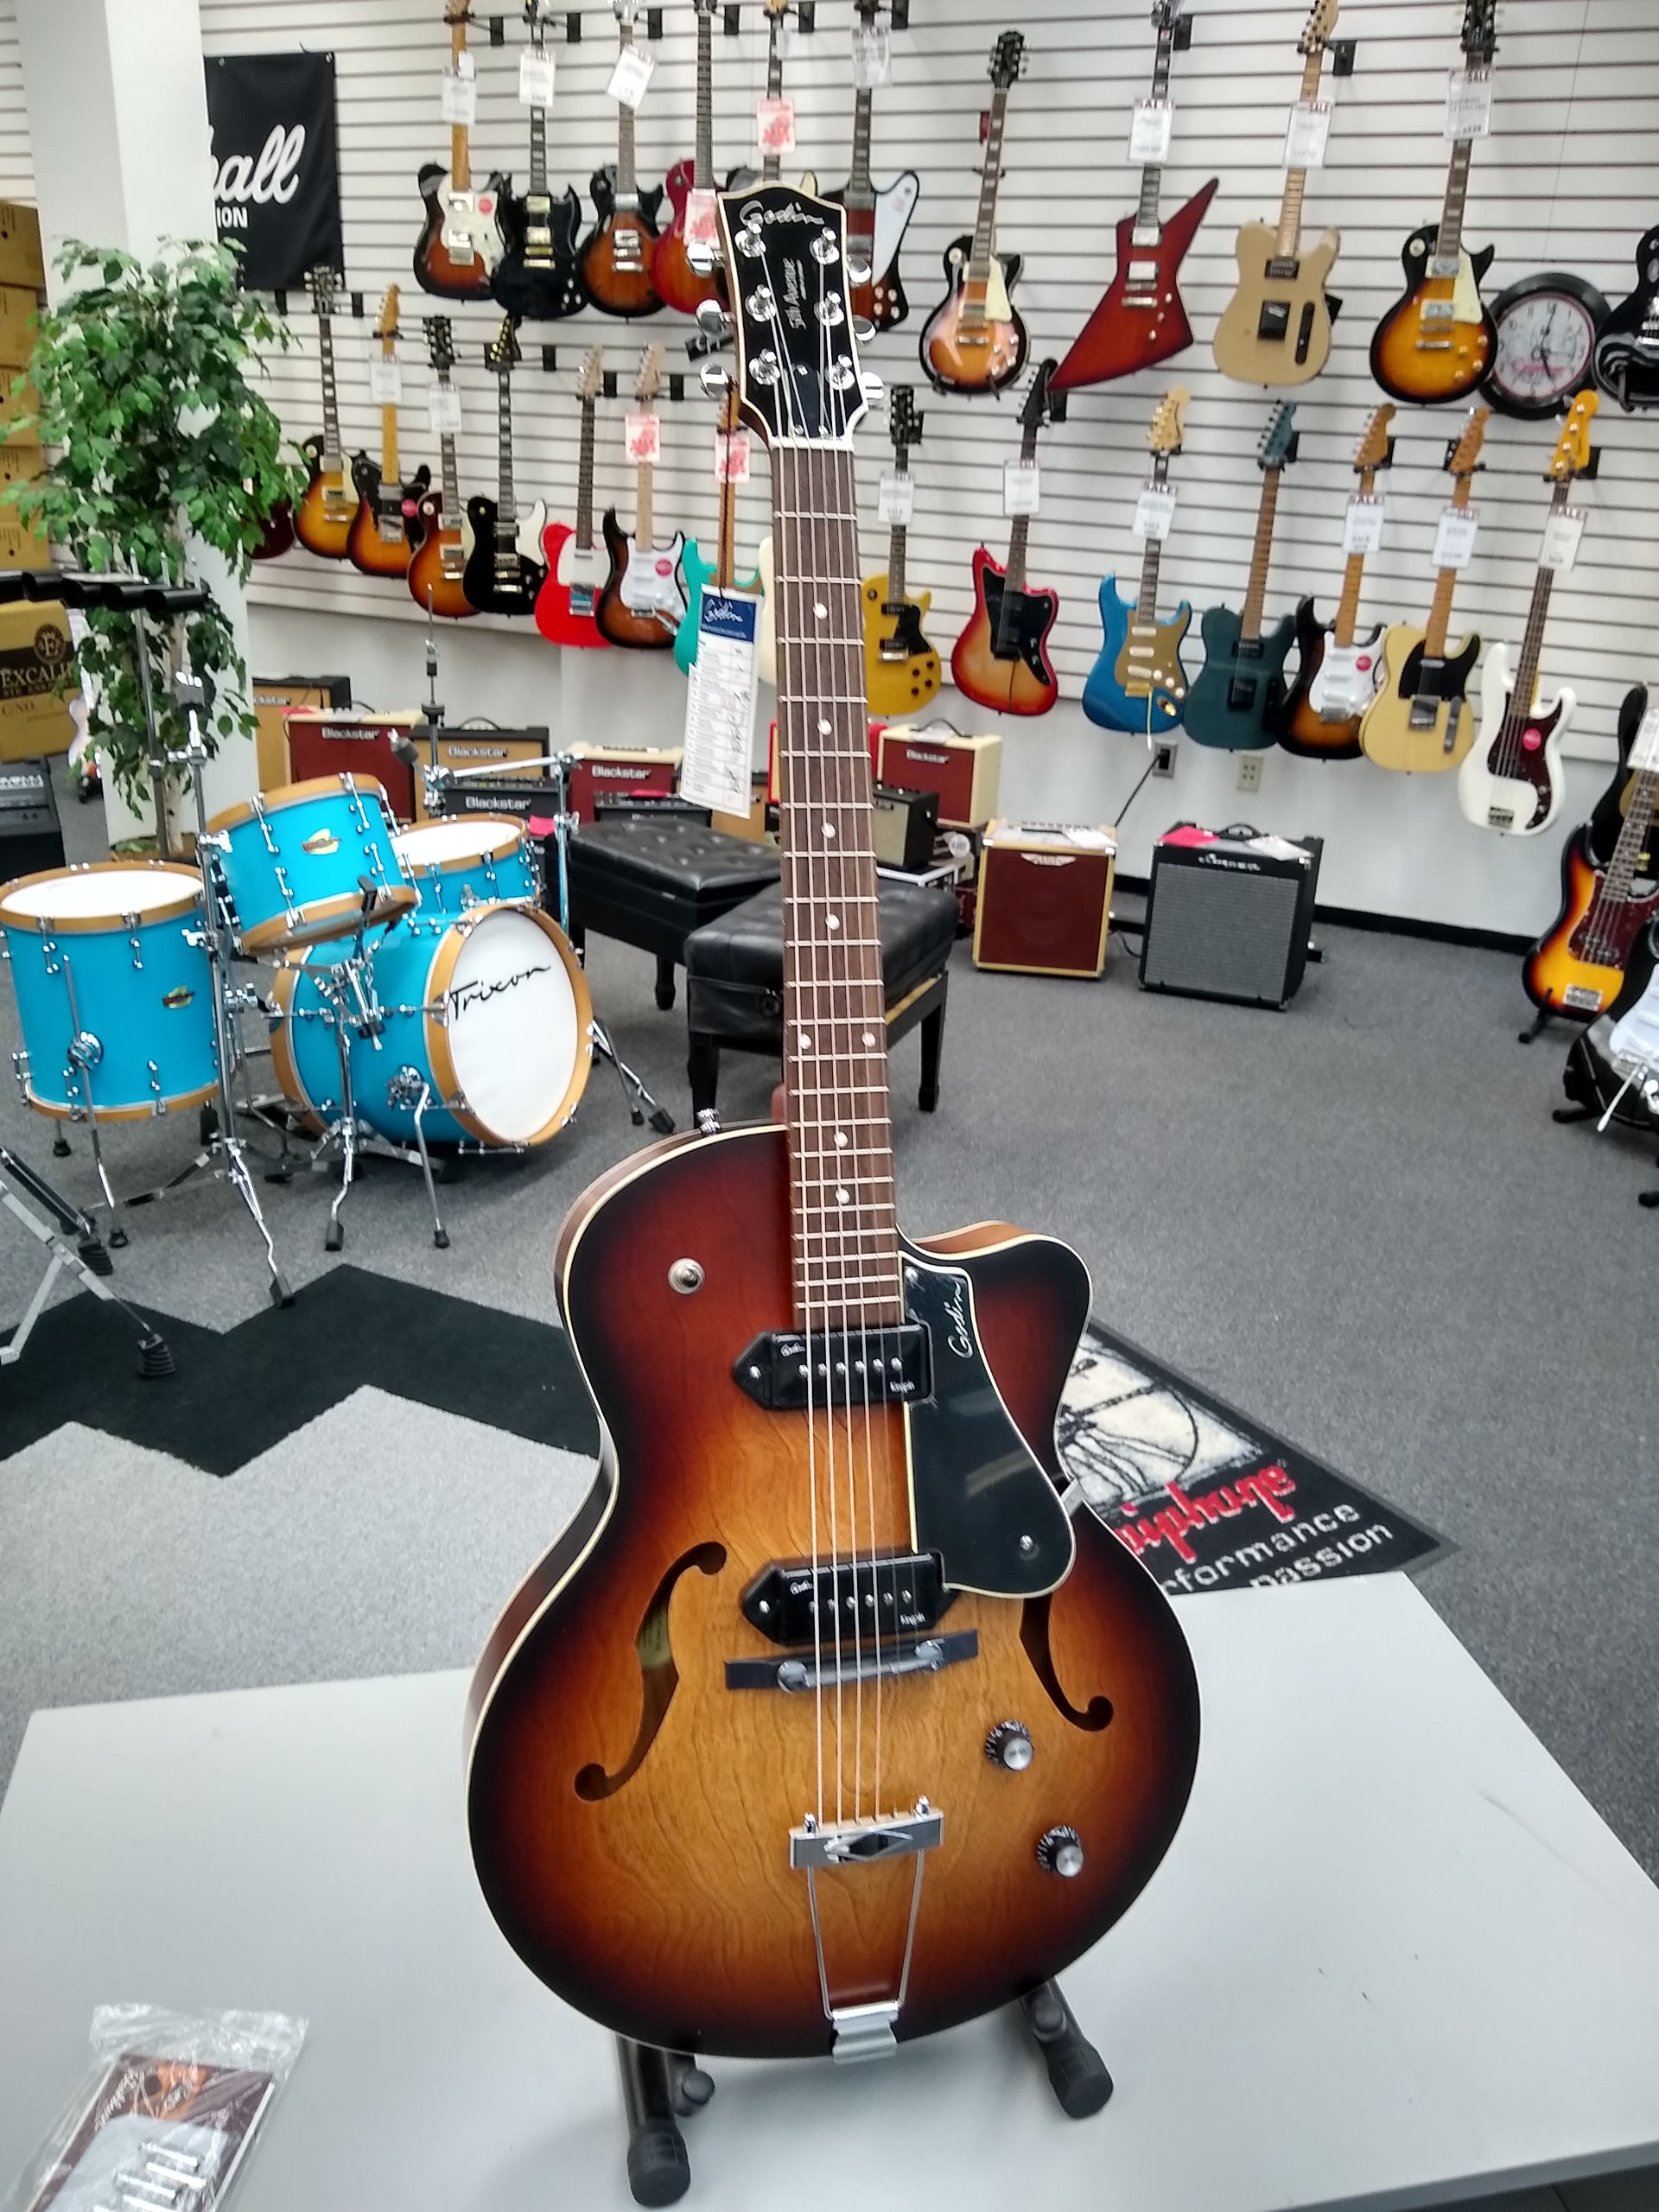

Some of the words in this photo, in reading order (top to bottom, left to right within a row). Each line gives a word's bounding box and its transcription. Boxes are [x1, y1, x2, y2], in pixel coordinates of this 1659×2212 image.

[739, 200, 825, 227] Godin
[782, 257, 801, 306] Avenue
[321, 728, 378, 741] Blackstar
[448, 746, 507, 758] Blackstar
[906, 749, 948, 765] Blackstar
[591, 765, 651, 779] Blackstar
[465, 796, 531, 810] Blackstar
[449, 965, 551, 1020] Trixon
[947, 1281, 973, 1358] Godin
[1115, 1464, 1296, 1565] iphone
